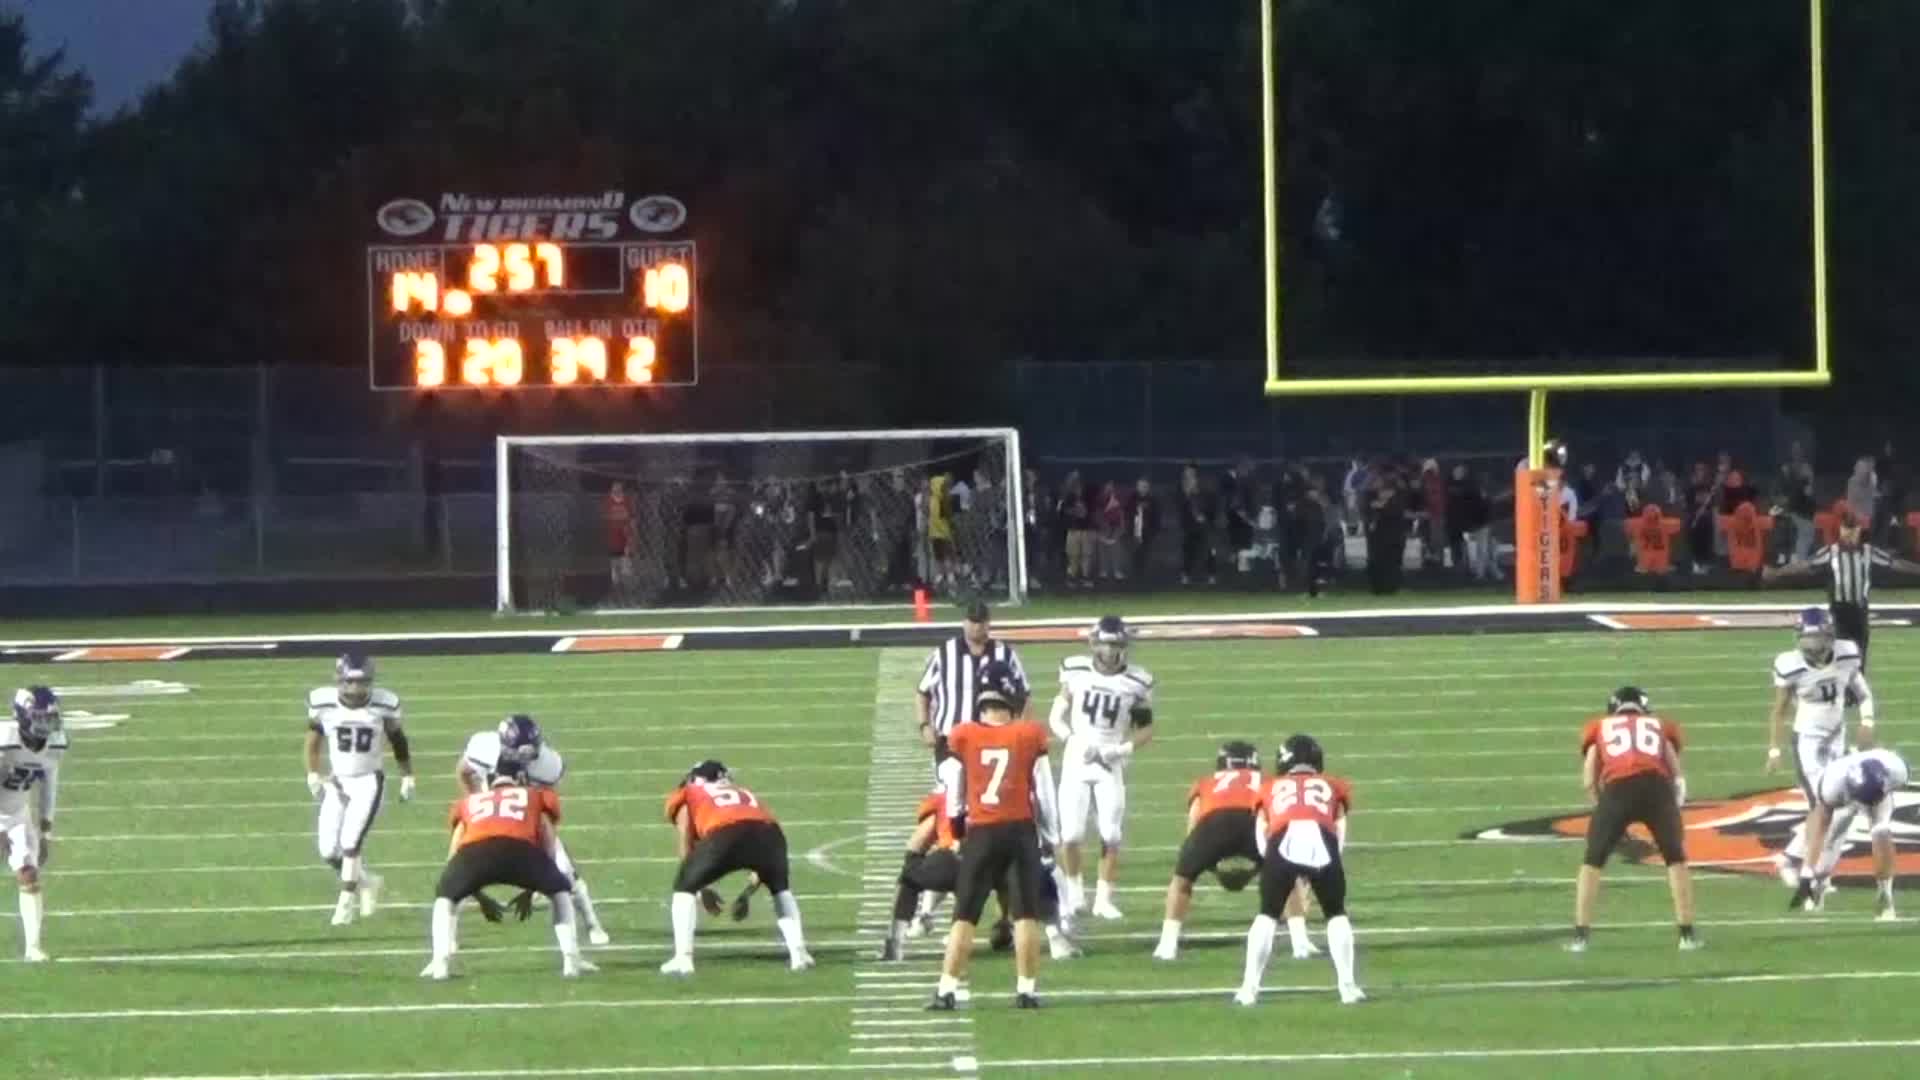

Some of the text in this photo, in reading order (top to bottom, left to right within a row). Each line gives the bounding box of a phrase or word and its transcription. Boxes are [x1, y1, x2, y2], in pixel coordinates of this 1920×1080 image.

[443, 213, 619, 241] TIGERS
[375, 252, 436, 272] HOME
[643, 263, 689, 313] 10
[399, 321, 457, 343] DOWN
[416, 337, 445, 387] 3
[462, 337, 523, 386] 20
[625, 335, 656, 384] 2
[1082, 690, 1121, 728] 44
[1601, 715, 1661, 756] 56
[980, 748, 1010, 804] 7
[468, 787, 529, 822] 52
[1271, 778, 1332, 815] 22
